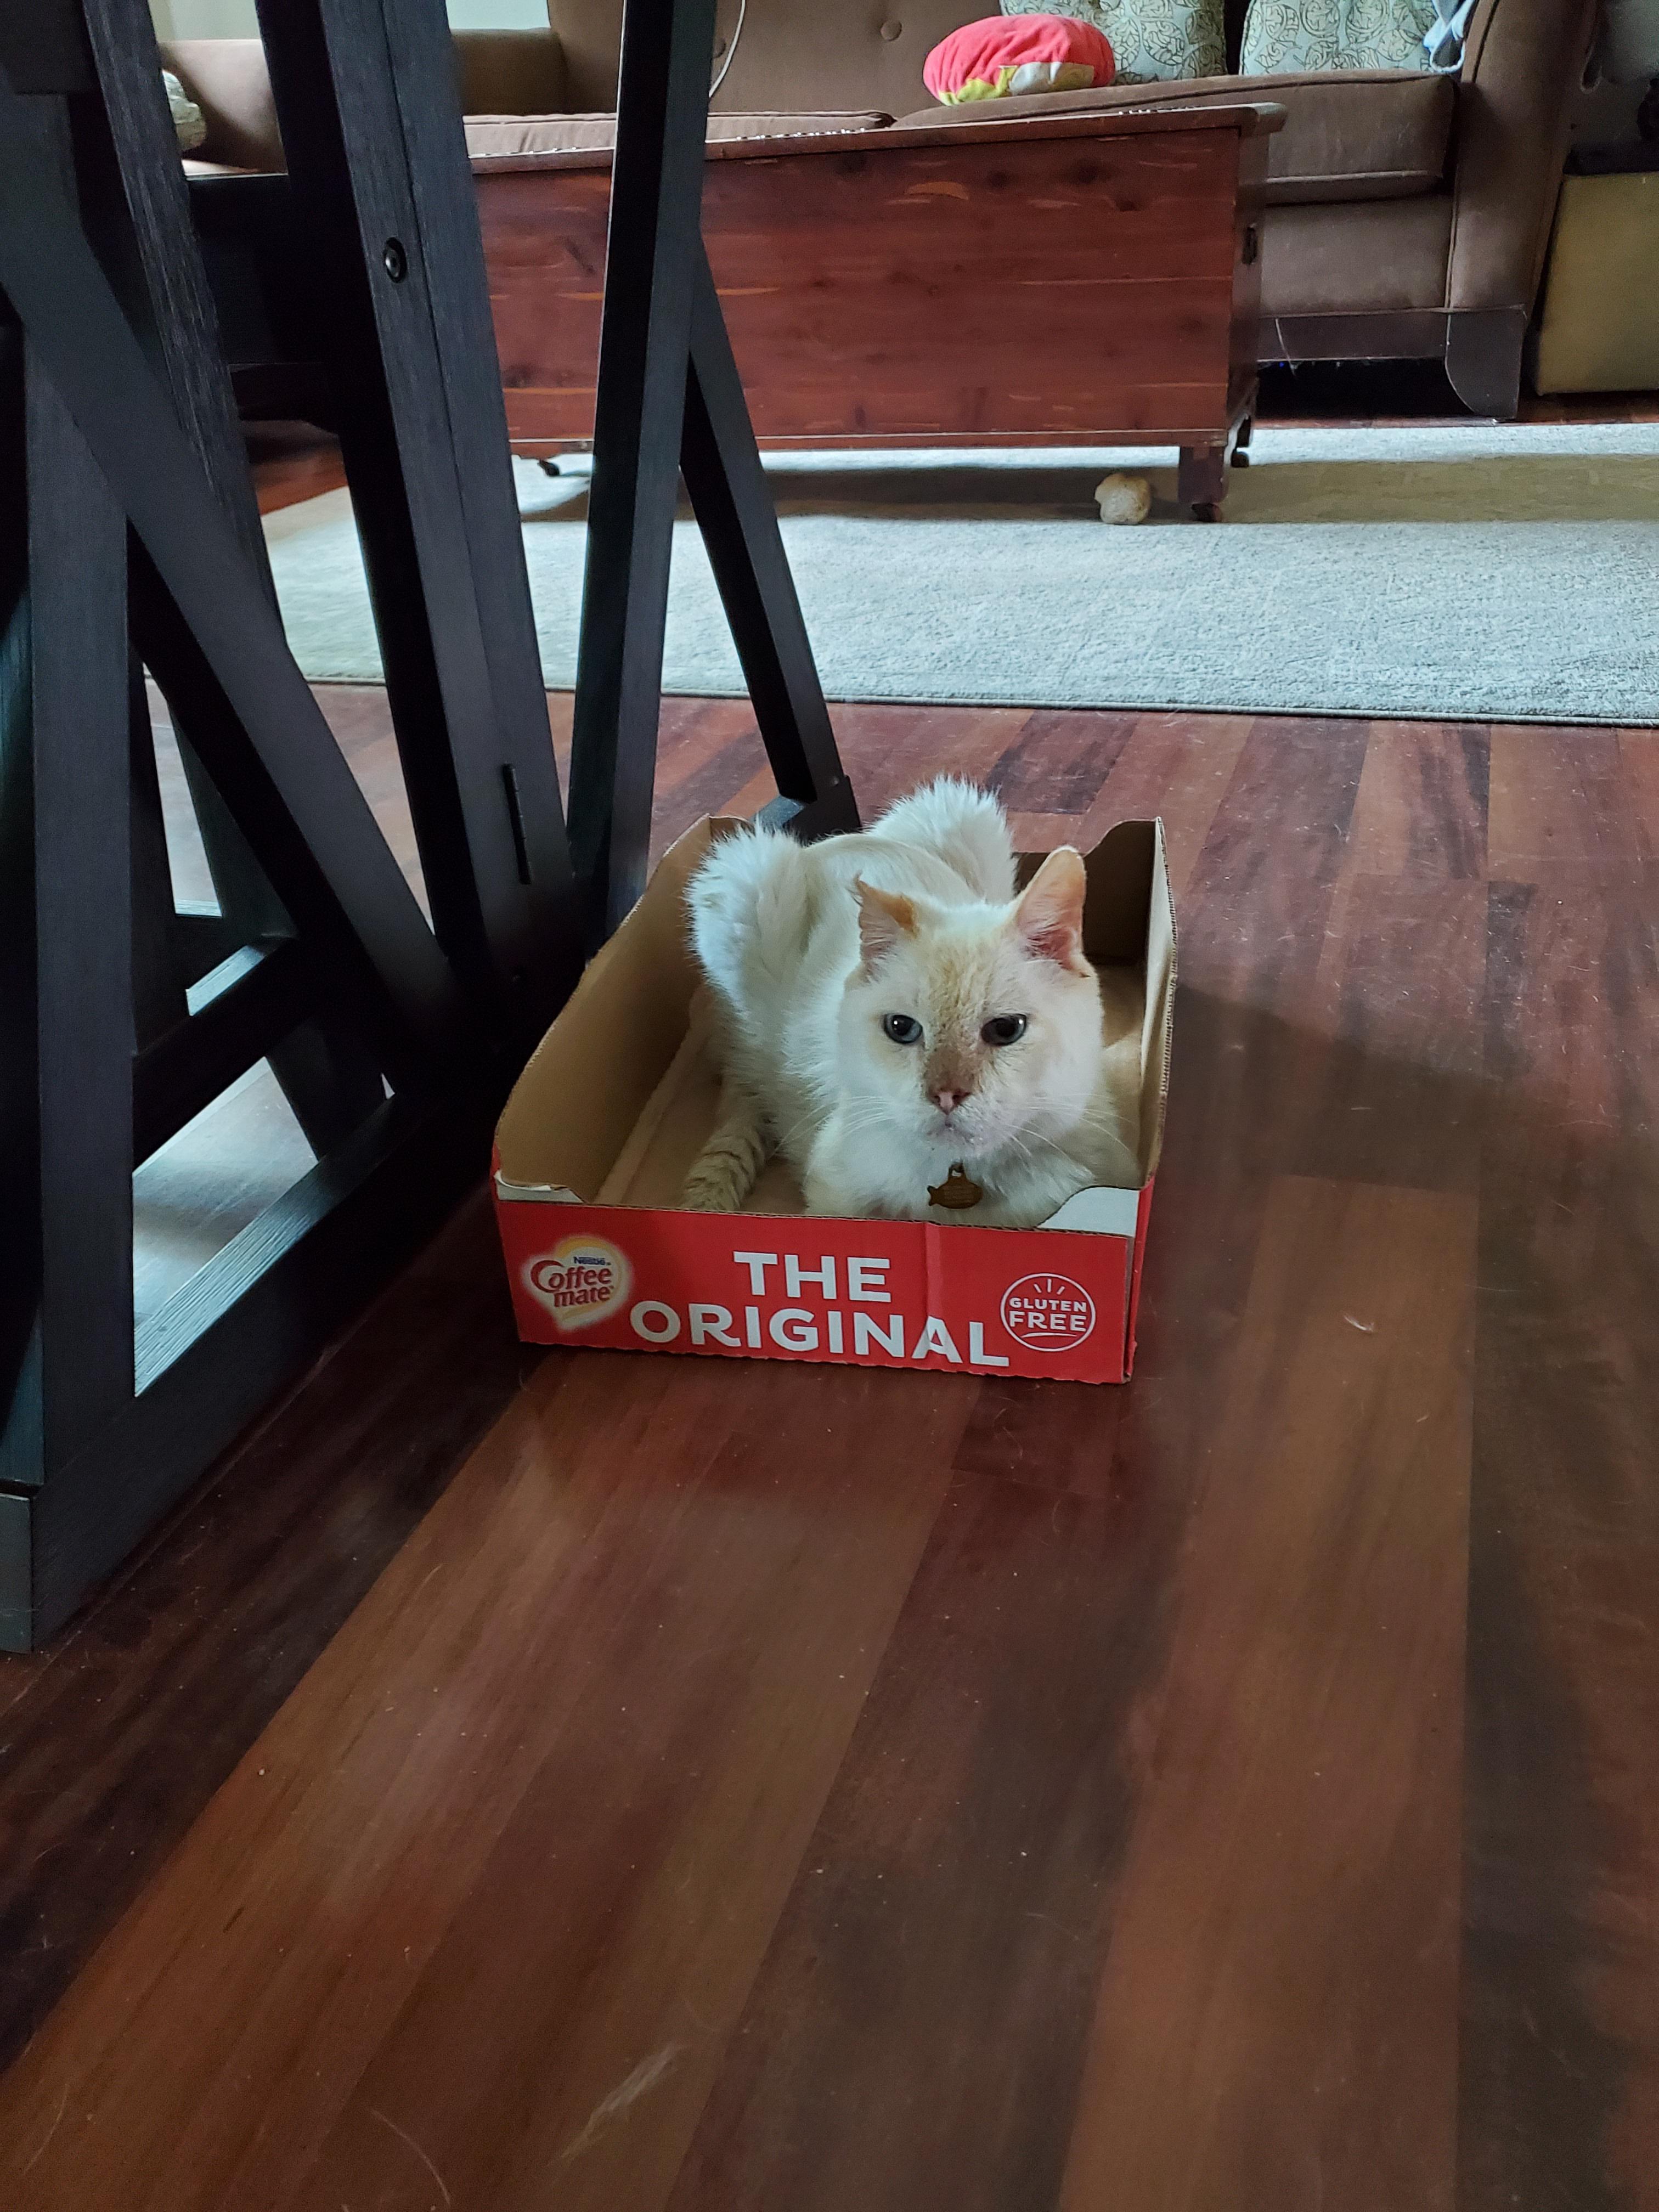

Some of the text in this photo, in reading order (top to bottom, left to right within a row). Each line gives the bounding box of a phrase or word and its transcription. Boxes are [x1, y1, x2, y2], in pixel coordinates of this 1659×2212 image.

[531, 1260, 613, 1294] Coffee
[733, 1251, 891, 1302] THE
[554, 1286, 611, 1307] mate
[1009, 1297, 1087, 1312] GLUTEN
[630, 1301, 1009, 1367] ORIGINAL
[1009, 1311, 1087, 1331] FREE
